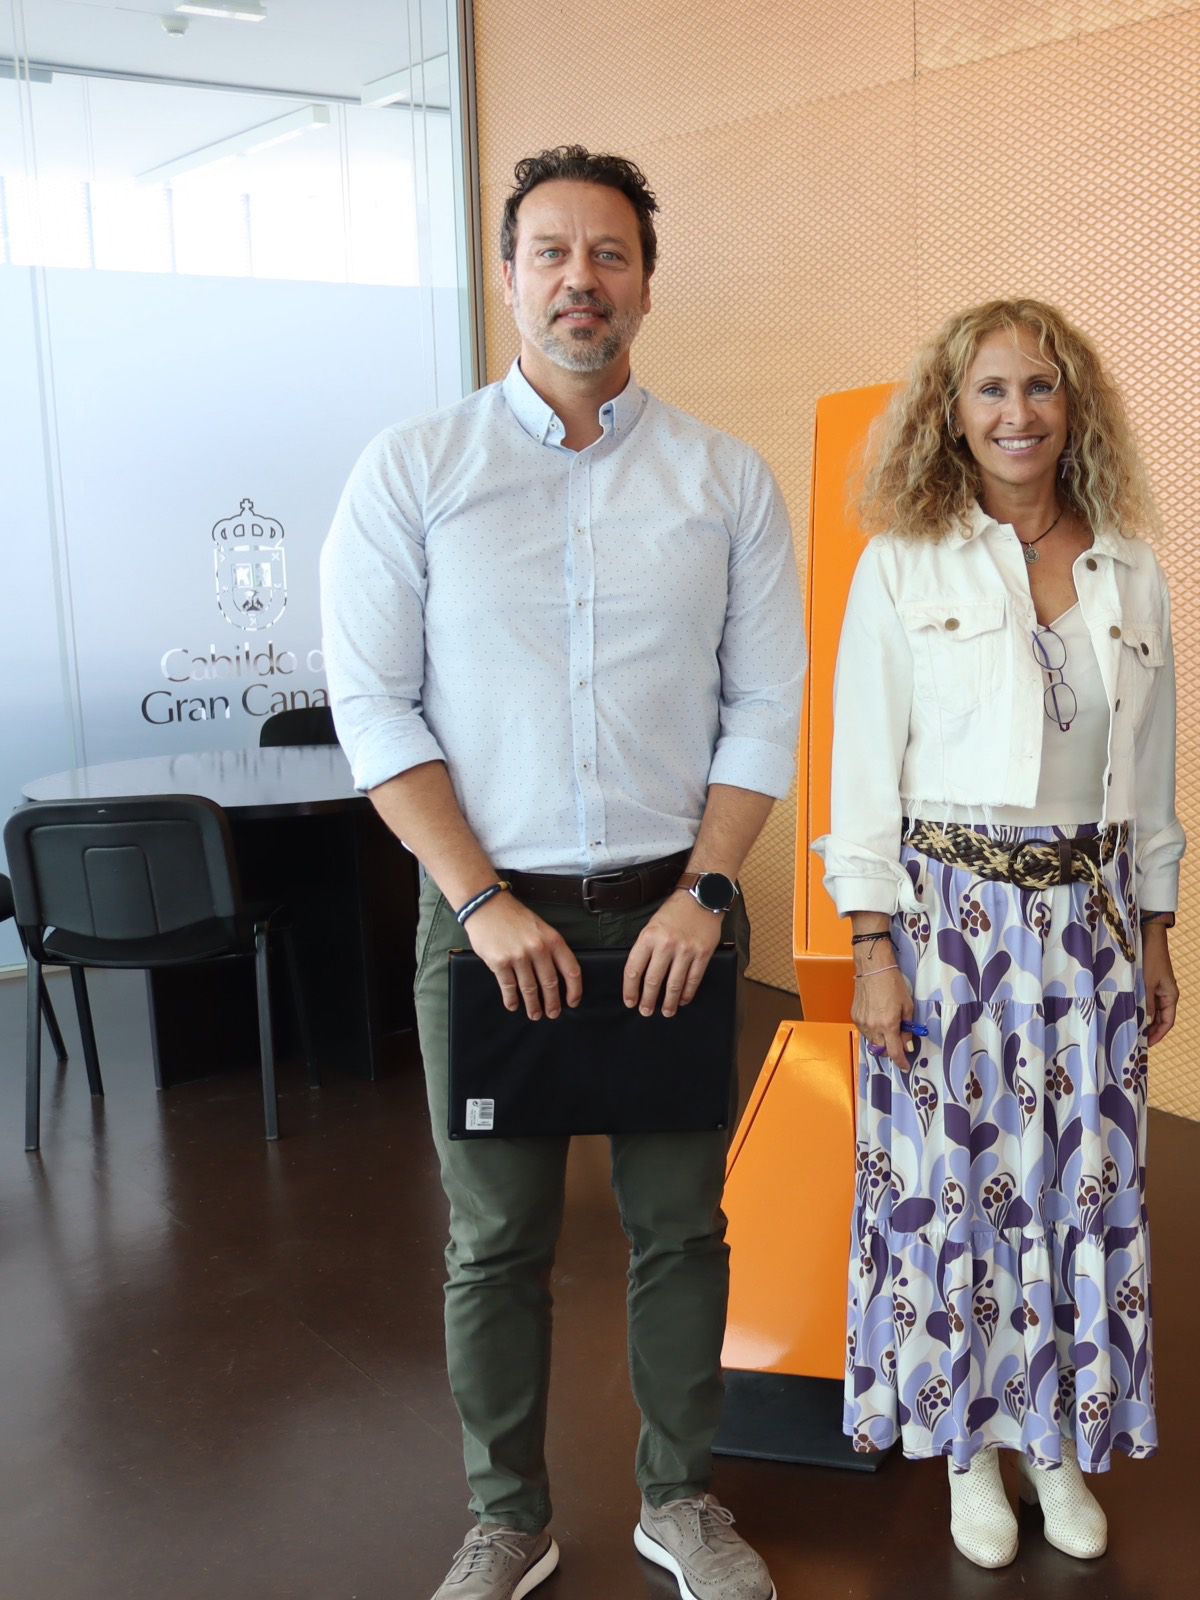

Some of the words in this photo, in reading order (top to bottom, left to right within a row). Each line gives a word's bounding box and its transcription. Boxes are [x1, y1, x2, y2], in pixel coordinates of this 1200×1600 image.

[160, 641, 298, 682] Cabildo
[141, 690, 230, 725] Gran
[242, 683, 329, 717] Cana
